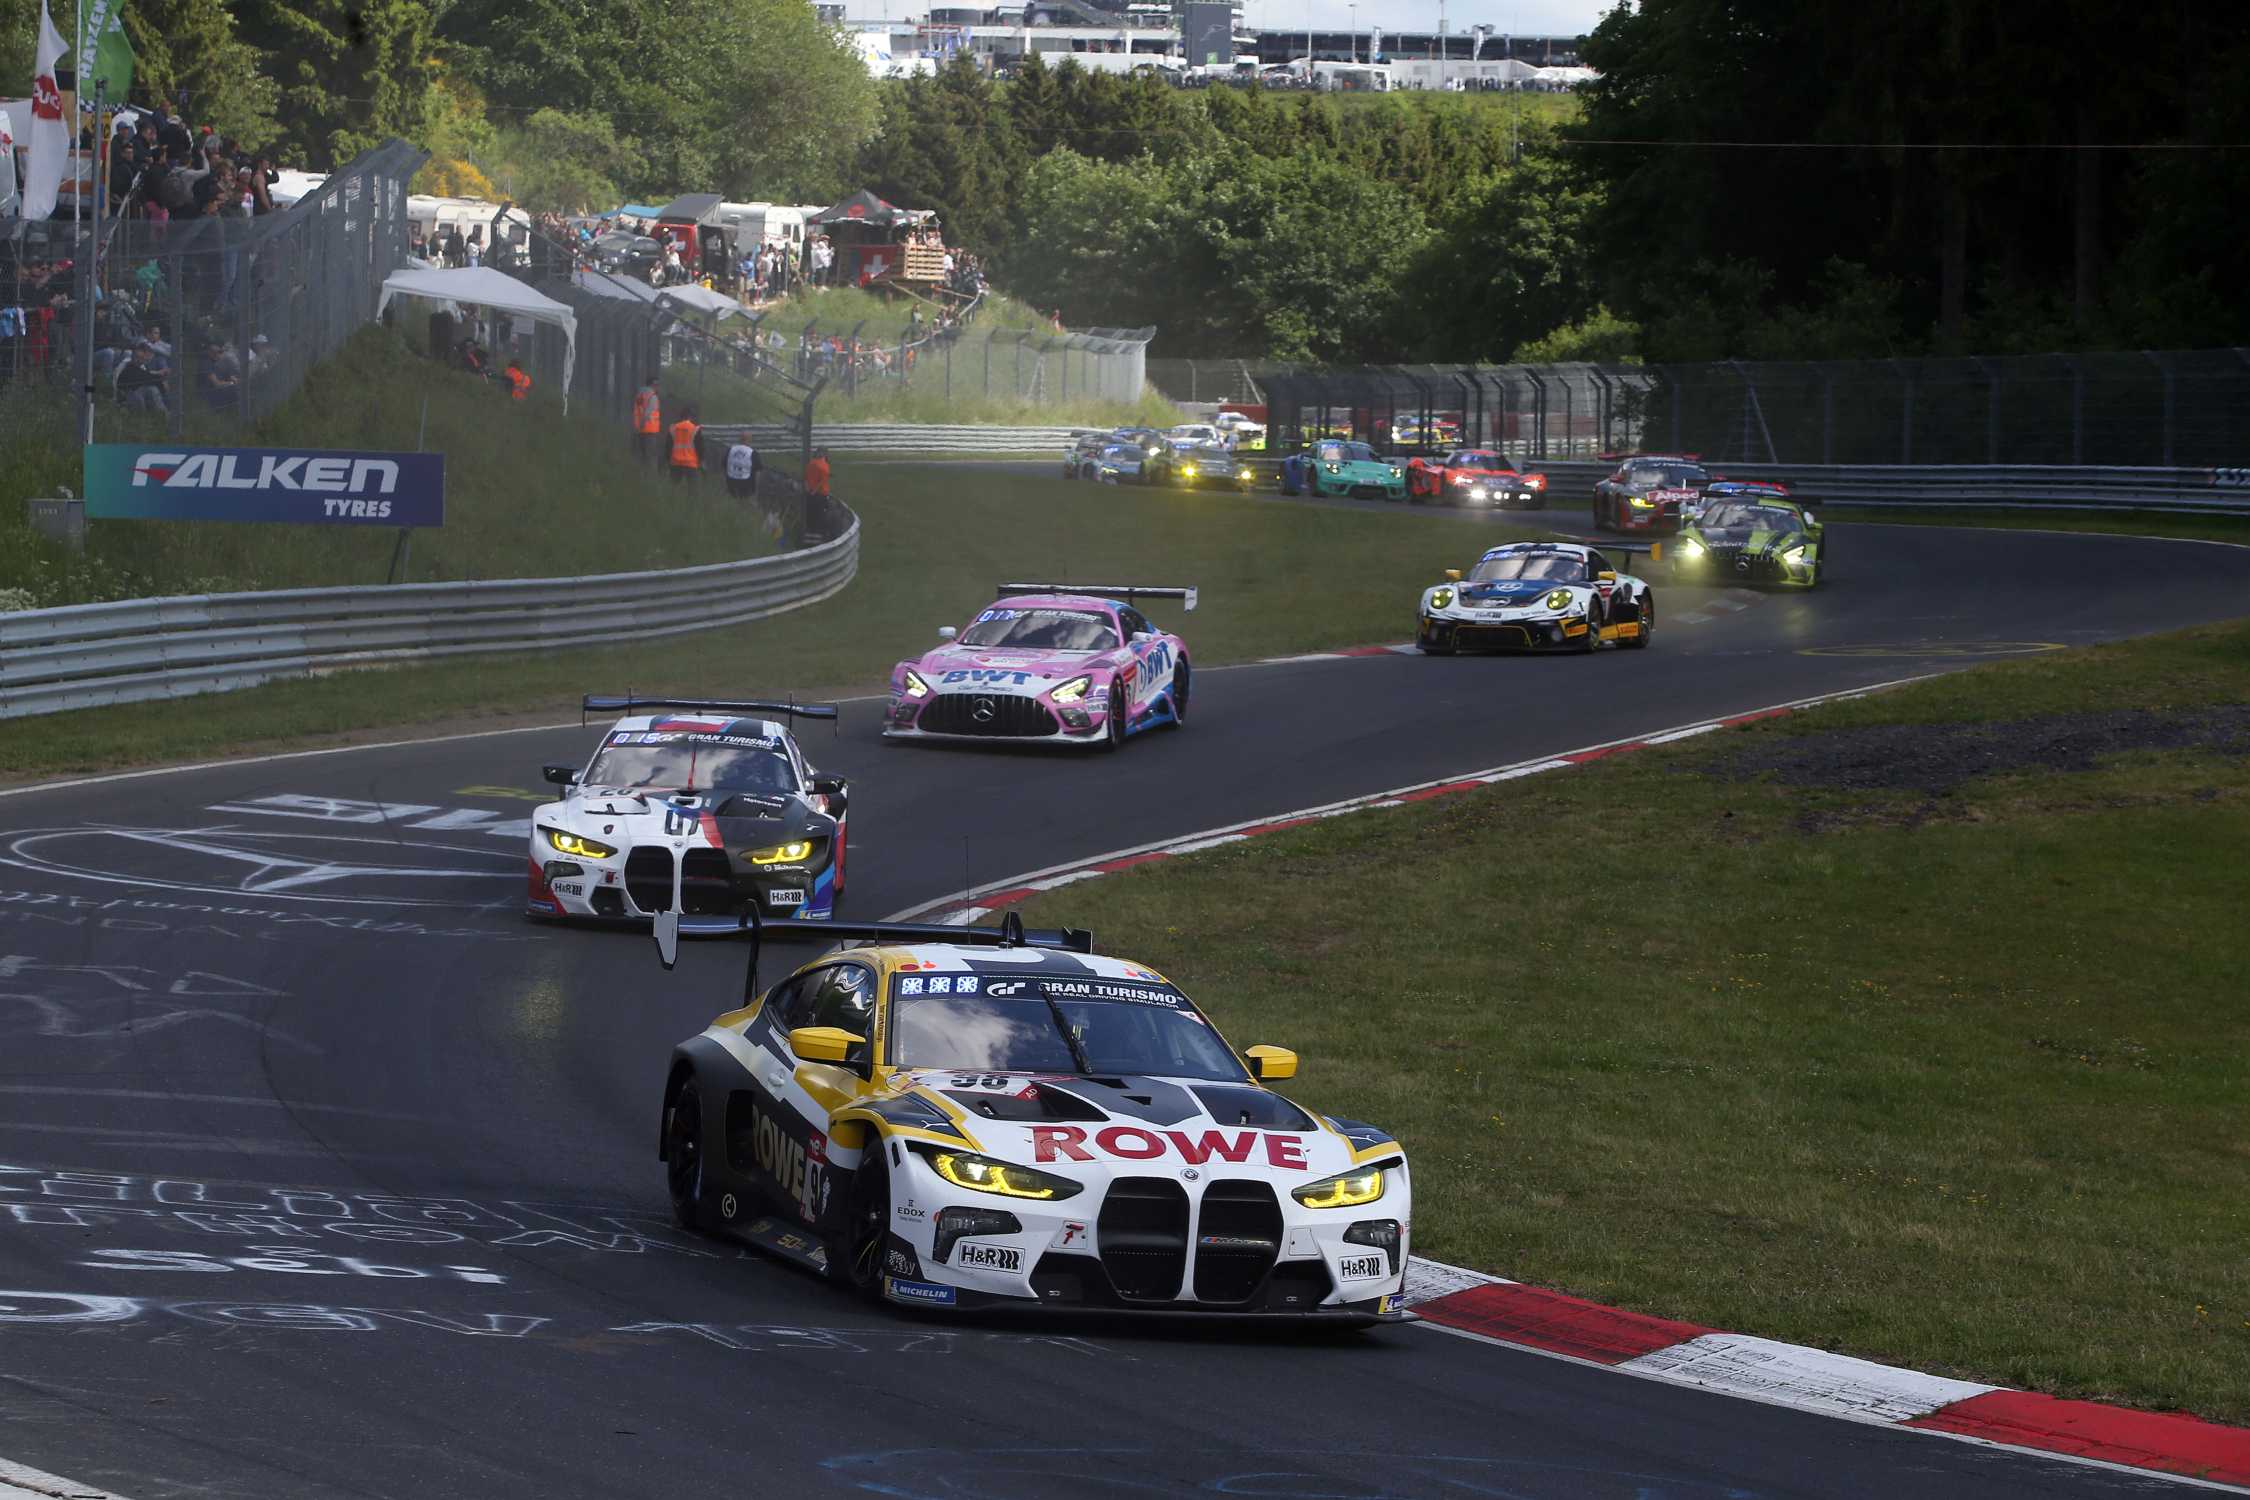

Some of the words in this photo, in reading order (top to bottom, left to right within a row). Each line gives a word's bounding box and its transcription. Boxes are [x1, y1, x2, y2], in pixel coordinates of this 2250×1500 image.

[131, 453, 399, 493] FALKEN
[324, 499, 391, 517] TYRES
[942, 670, 1032, 685] BWT
[688, 734, 721, 742] GRAN
[723, 736, 775, 747] TURISMO
[1095, 985, 1177, 1004] TURISMO
[1031, 1125, 1308, 1171] ROWE
[897, 1207, 925, 1217] EDOX
[899, 1286, 948, 1298] MICHELIN
